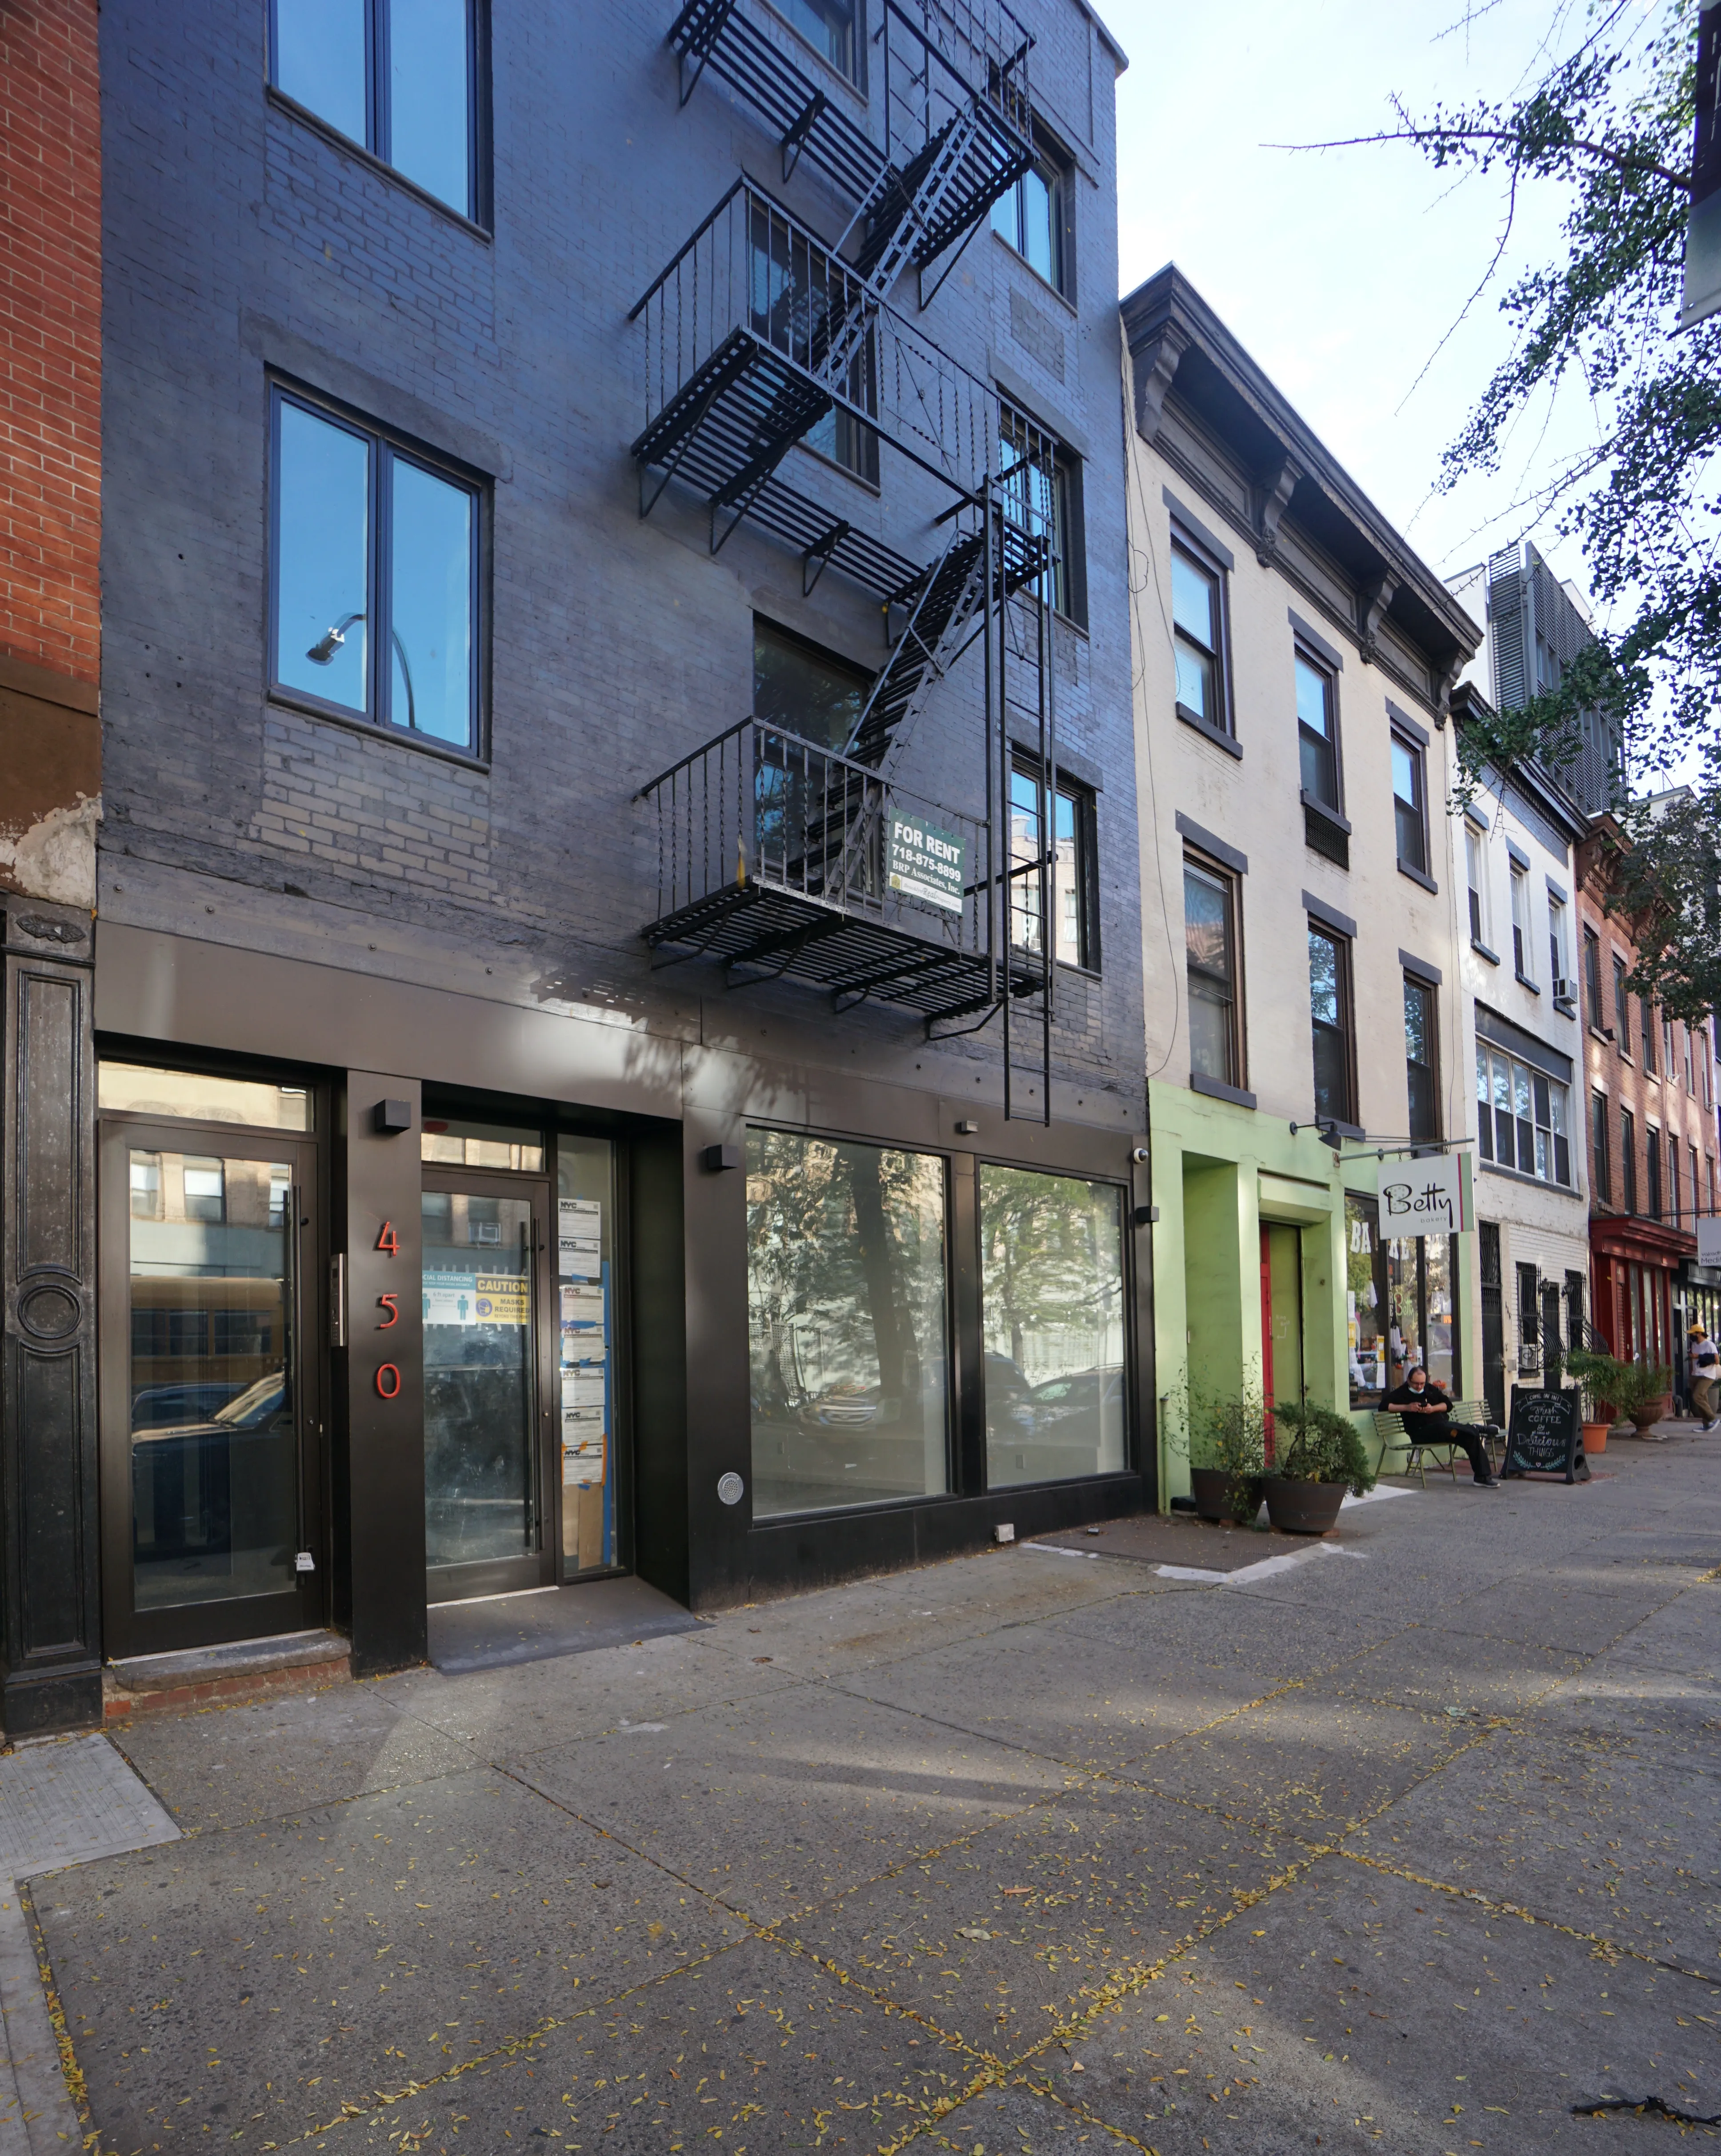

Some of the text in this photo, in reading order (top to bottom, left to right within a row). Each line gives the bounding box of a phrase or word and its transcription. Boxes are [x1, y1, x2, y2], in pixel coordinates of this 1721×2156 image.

[894, 822, 961, 864] FOR RENT
[892, 843, 961, 882] 718-875-8899
[893, 860, 910, 874] BRP
[911, 867, 947, 891] Associates,
[948, 882, 960, 895] Inc.
[560, 1201, 577, 1209] NYC
[1383, 1182, 1453, 1229] Betty
[560, 1240, 577, 1248] NYC
[477, 1280, 528, 1293] CAUTION
[1394, 1292, 1415, 1330] Betty
[1528, 1415, 1561, 1424] COFFEE
[1516, 1433, 1566, 1447] Delicious
[1527, 1446, 1554, 1458] THINGS
